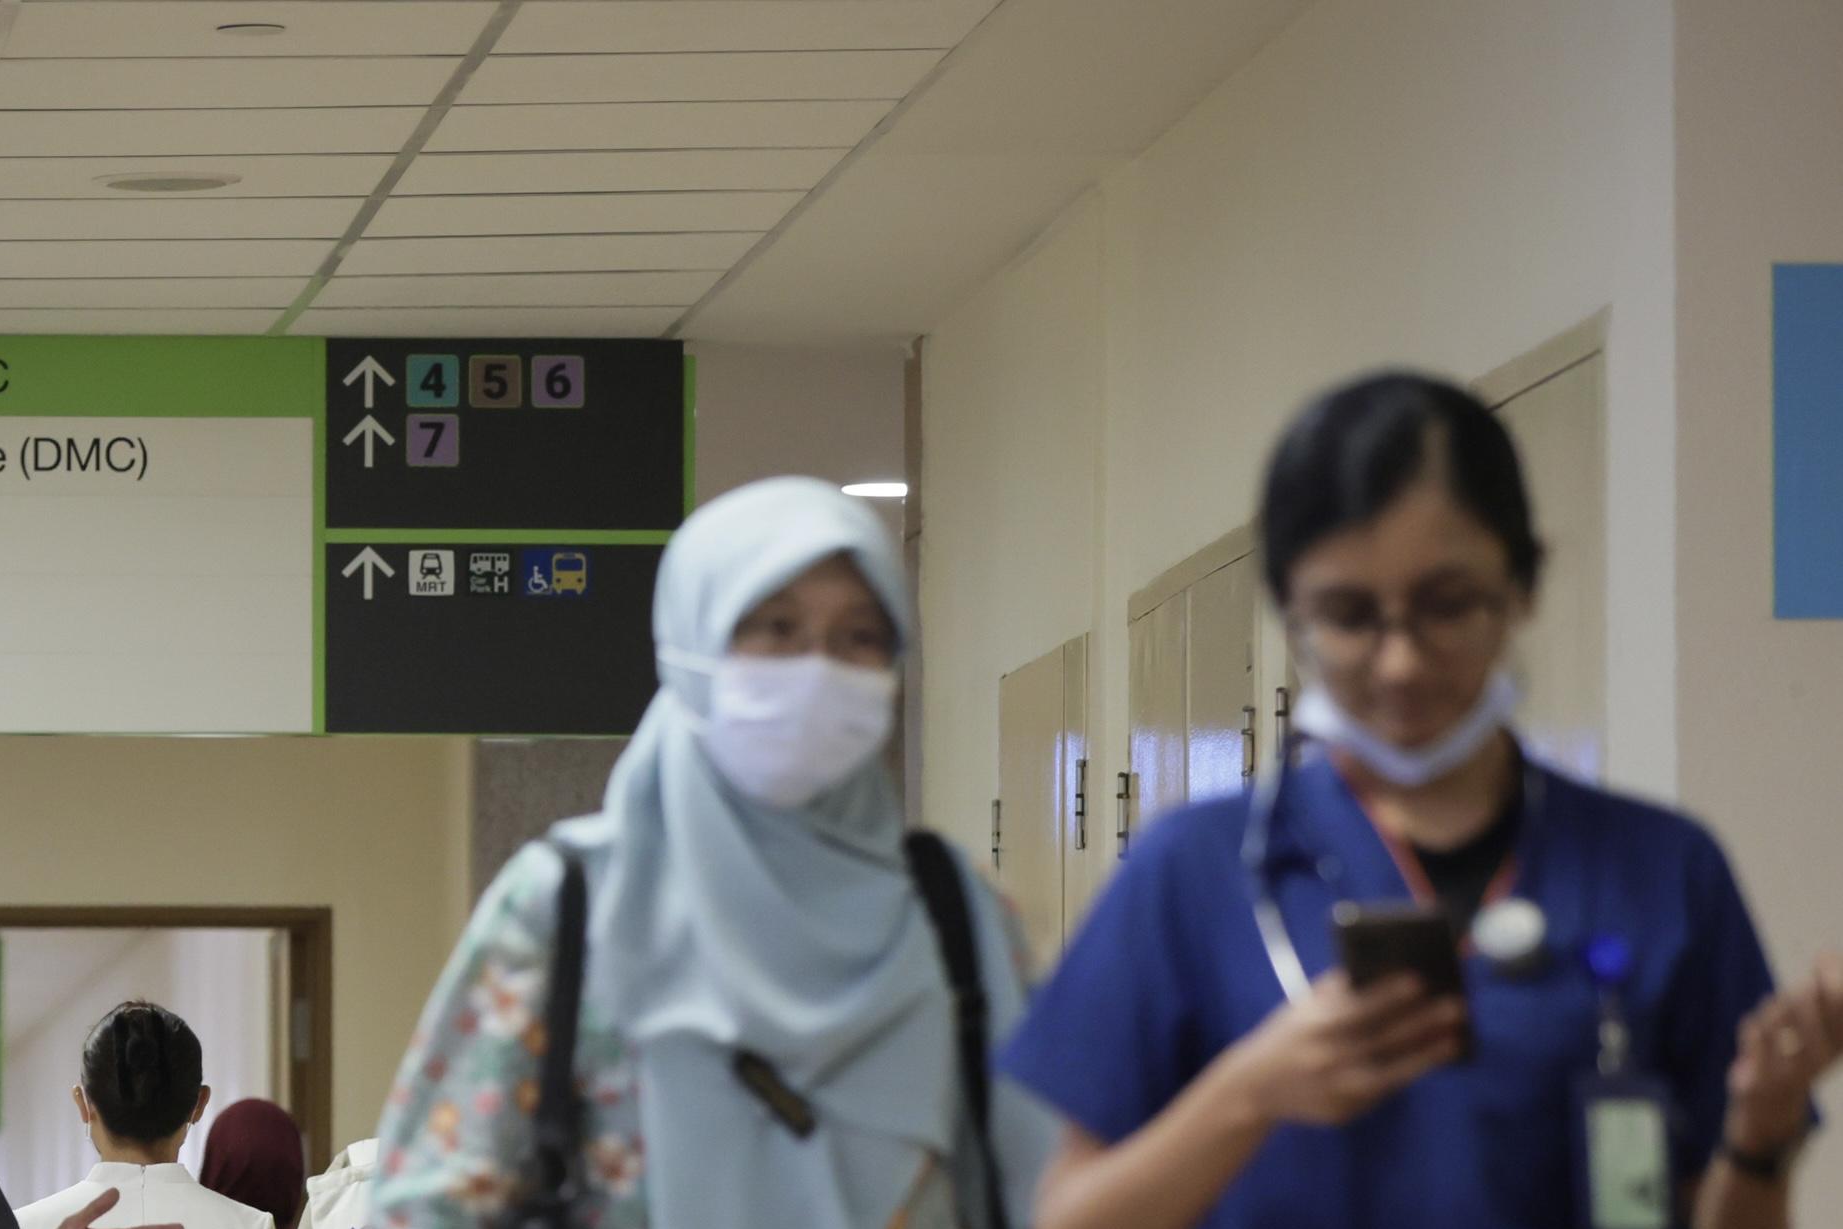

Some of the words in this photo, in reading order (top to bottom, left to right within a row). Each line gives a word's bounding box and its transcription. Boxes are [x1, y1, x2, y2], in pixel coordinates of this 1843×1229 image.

[419, 362, 447, 399] 4
[483, 363, 508, 400] 5
[545, 363, 572, 400] 6
[19, 436, 149, 481] (DMC)
[418, 421, 446, 459] 7
[415, 581, 447, 594] MRT
